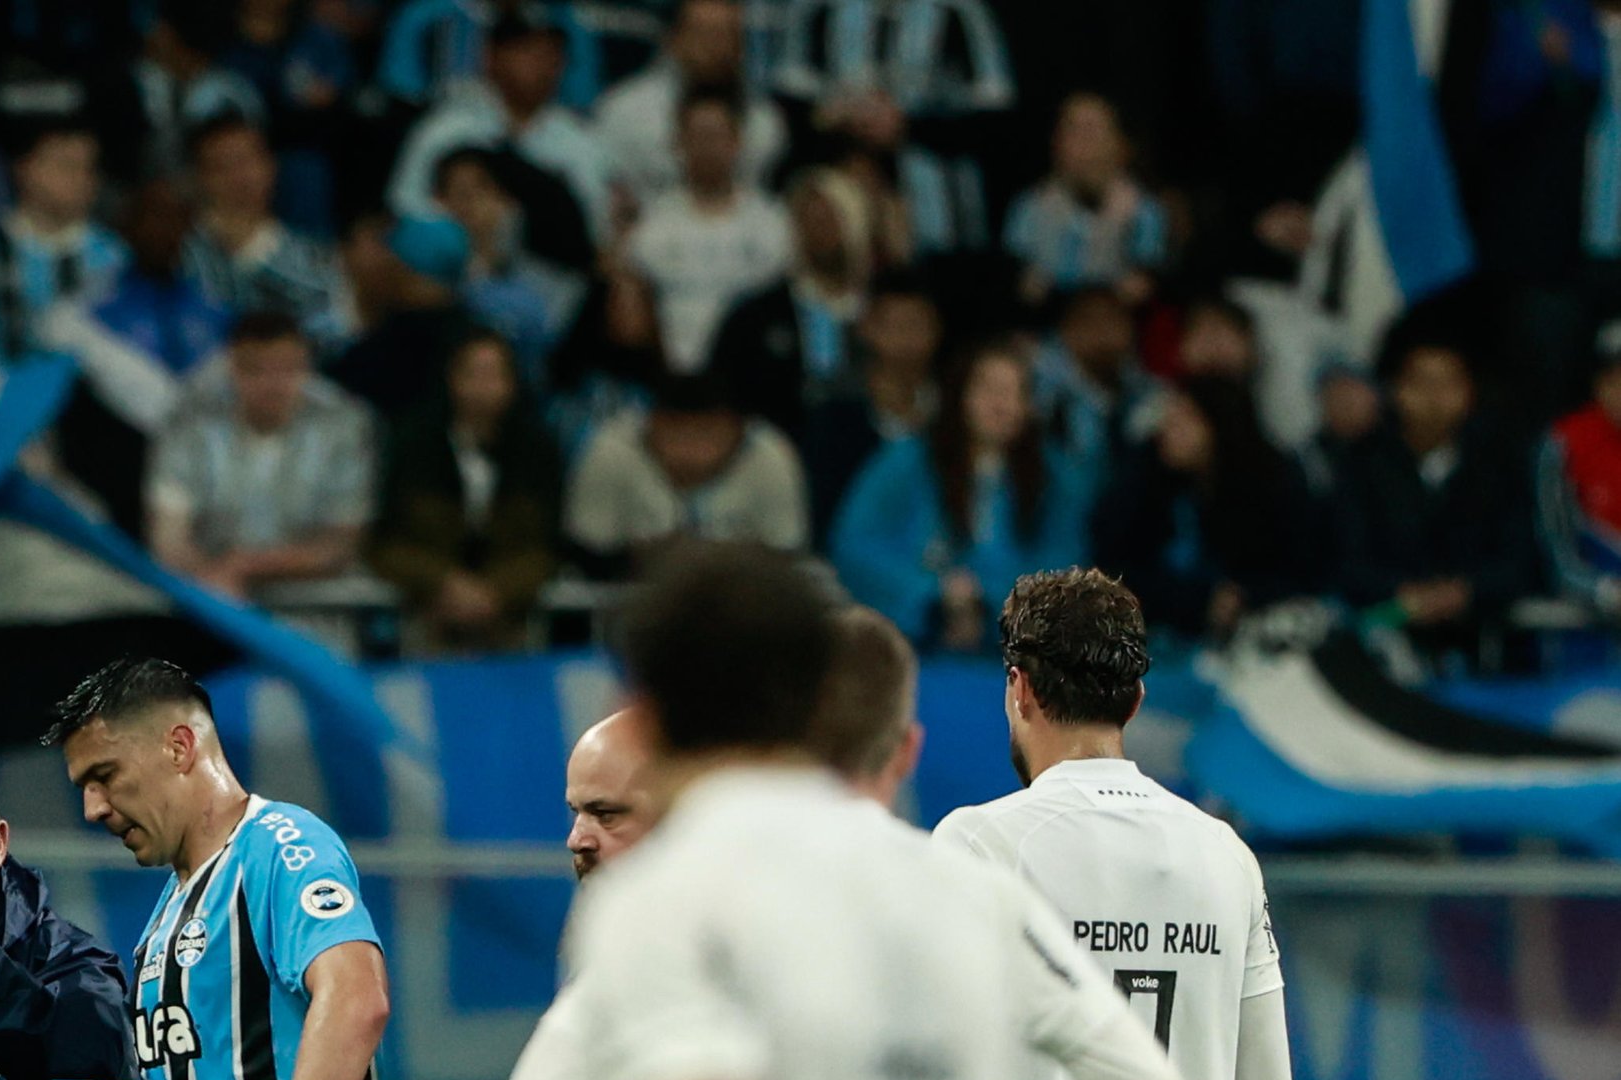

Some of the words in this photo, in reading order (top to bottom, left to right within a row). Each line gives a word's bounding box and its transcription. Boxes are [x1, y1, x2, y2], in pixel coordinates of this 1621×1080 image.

[1074, 920, 1149, 952] PEDRO
[1163, 922, 1221, 955] RAUL
[1132, 976, 1160, 988] voke
[135, 1004, 196, 1063] lfa
